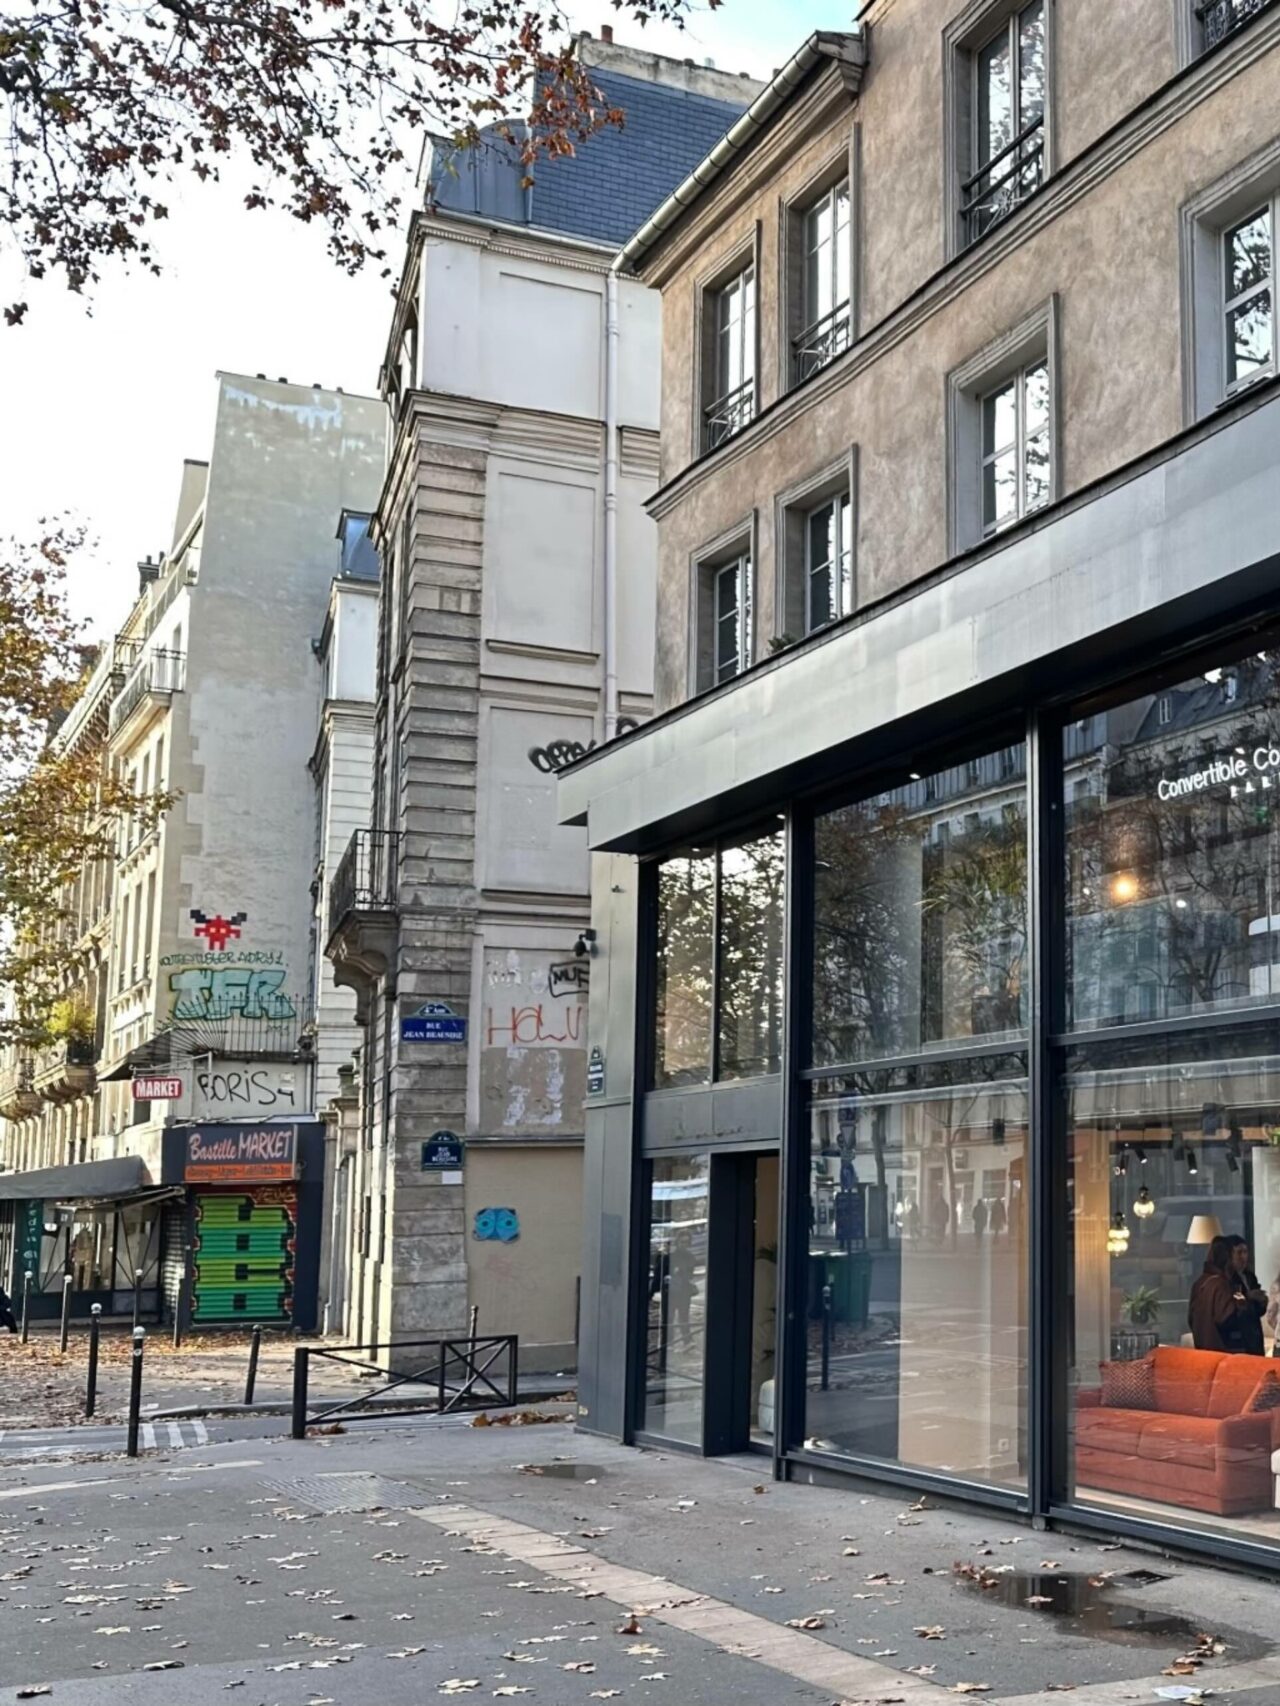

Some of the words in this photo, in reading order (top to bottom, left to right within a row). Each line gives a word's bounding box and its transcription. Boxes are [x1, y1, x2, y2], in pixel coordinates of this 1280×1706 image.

[1157, 757, 1248, 801] Convertible
[403, 1031, 424, 1039] JEAN
[426, 1022, 441, 1030] RUE
[135, 1080, 181, 1098] MARKET
[188, 1133, 237, 1161] Bastille
[237, 1130, 292, 1160] MARKET
